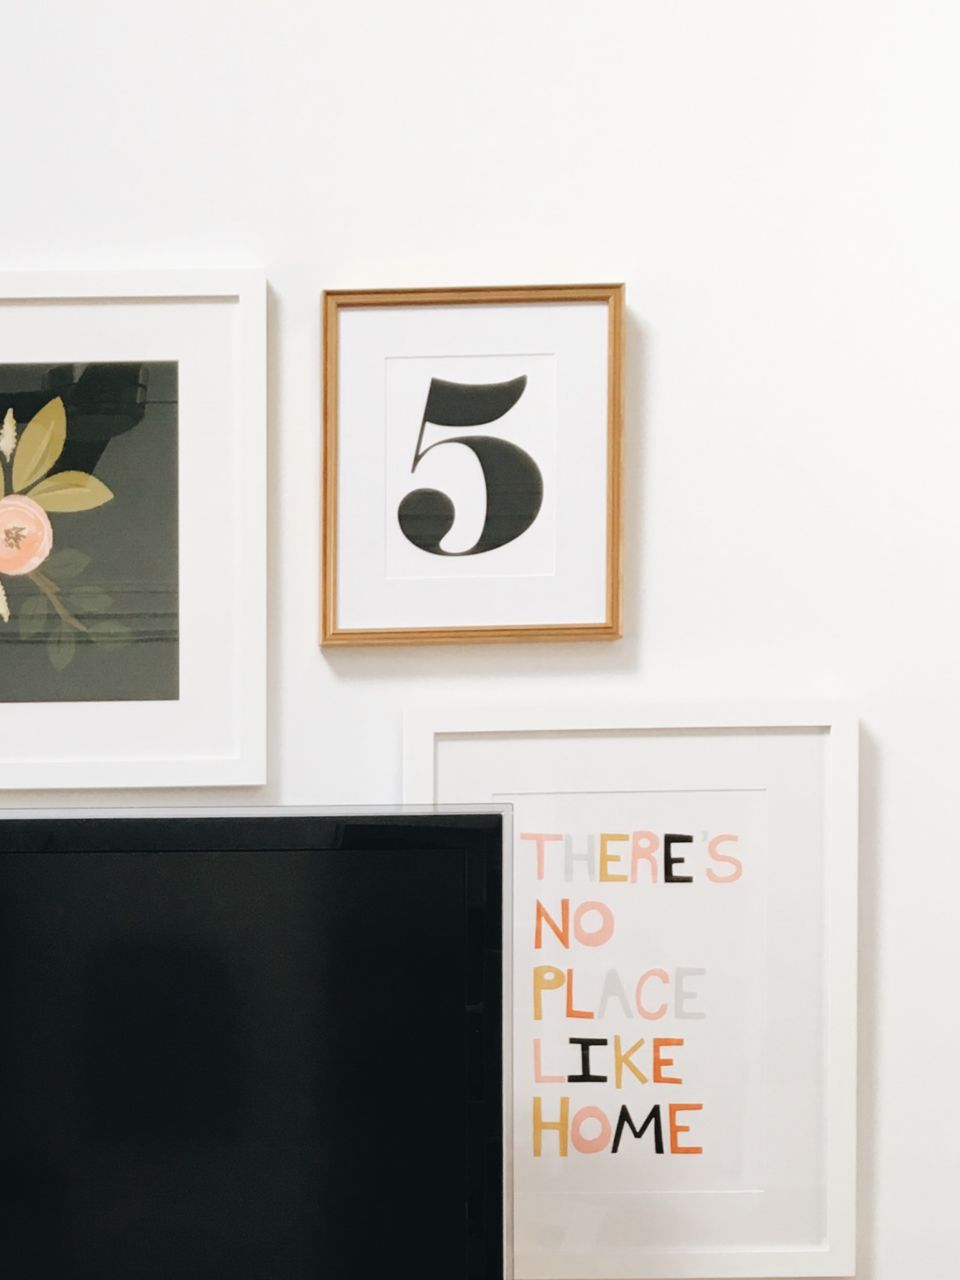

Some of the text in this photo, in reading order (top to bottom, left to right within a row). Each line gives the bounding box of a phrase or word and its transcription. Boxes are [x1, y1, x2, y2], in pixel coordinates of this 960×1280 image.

[398, 374, 544, 556] 5
[520, 830, 743, 884] THERE'S
[534, 898, 615, 950] NO
[533, 965, 707, 1021] PLACE
[533, 1035, 685, 1089] LIKE
[532, 1096, 704, 1158] HOME
